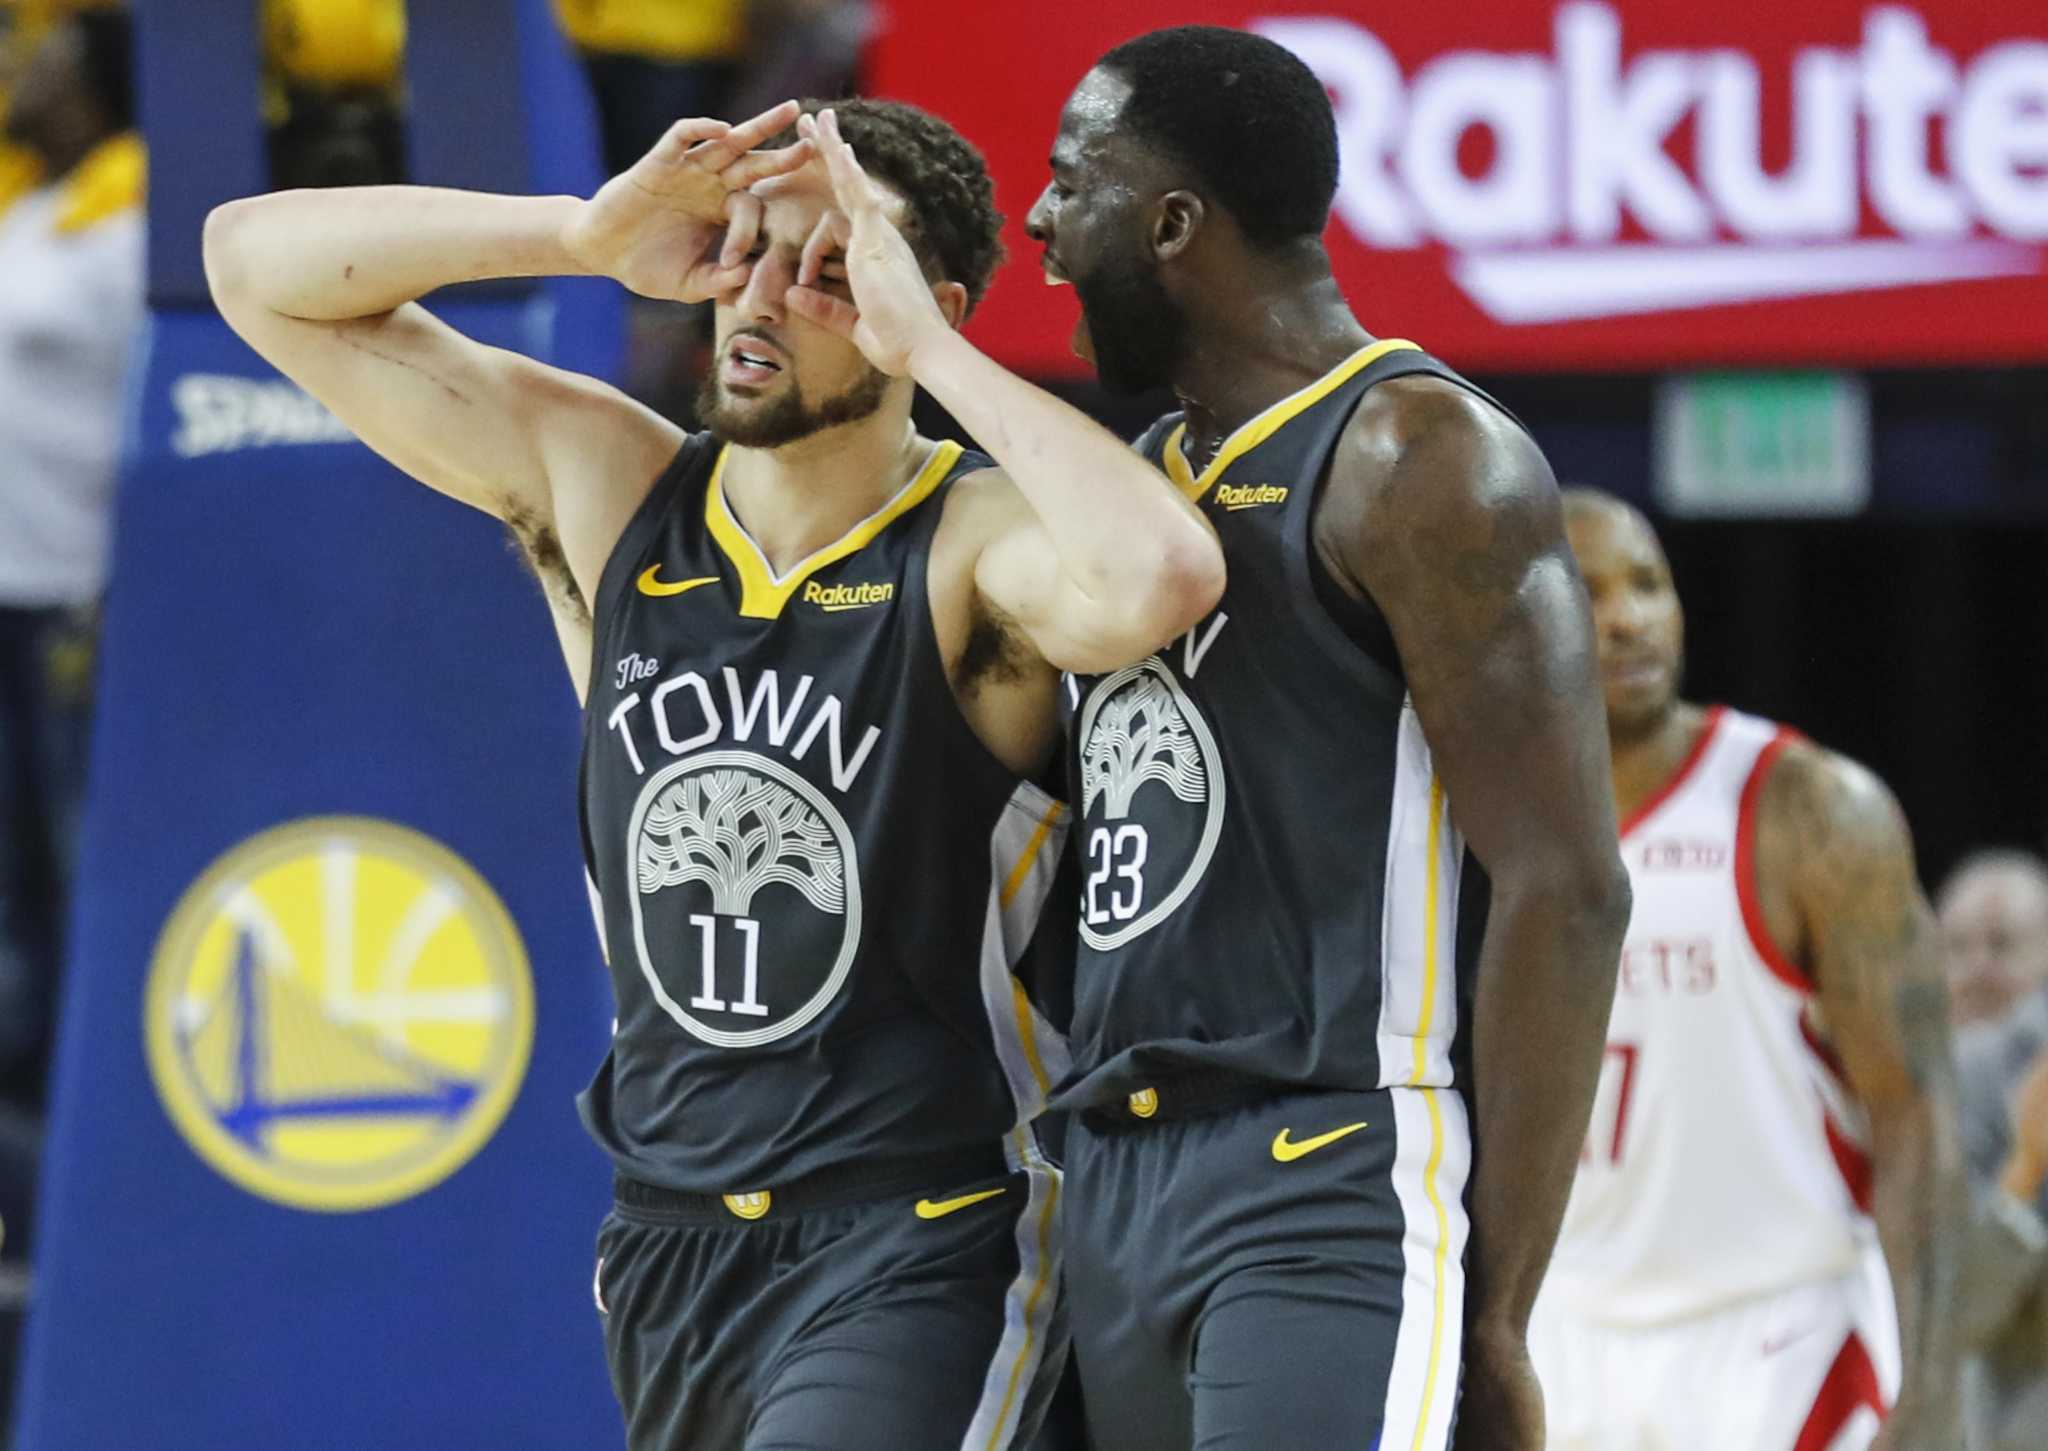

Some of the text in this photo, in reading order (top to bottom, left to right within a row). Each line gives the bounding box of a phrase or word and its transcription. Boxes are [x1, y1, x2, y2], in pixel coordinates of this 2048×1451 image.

[1214, 483, 1288, 504] Rakuten
[803, 580, 893, 605] Rakuten
[615, 652, 659, 690] The
[608, 666, 881, 793] TOWN
[1087, 824, 1148, 925] 23
[689, 914, 768, 1016] 11
